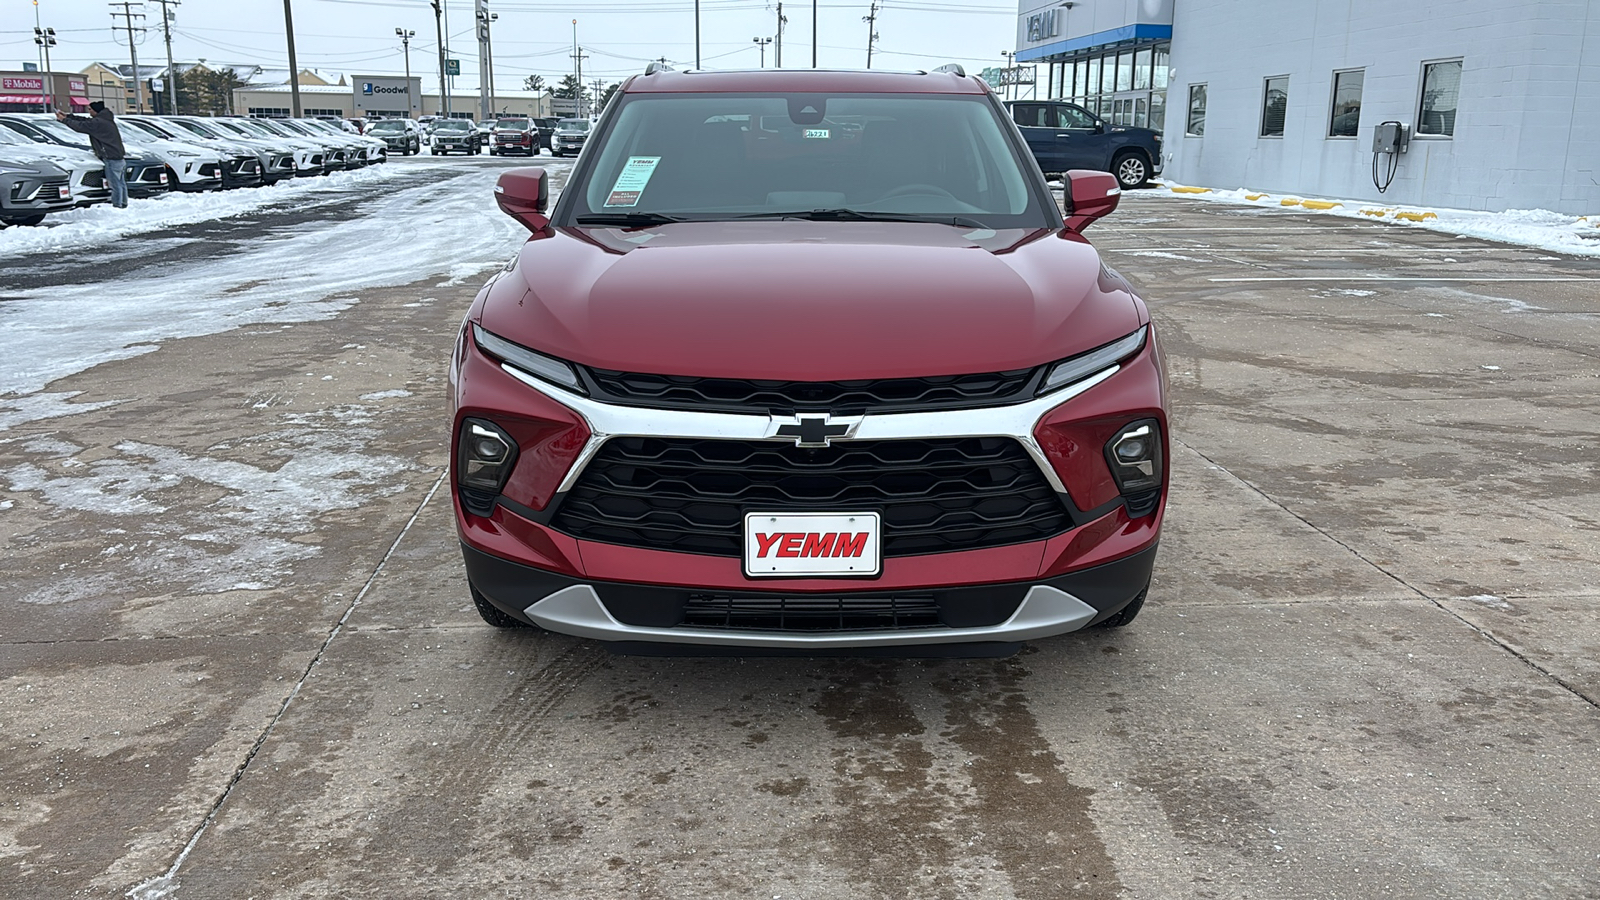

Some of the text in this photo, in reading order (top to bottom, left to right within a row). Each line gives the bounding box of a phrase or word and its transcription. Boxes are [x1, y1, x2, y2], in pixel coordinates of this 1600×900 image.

[1026, 9, 1060, 42] YEMM
[373, 85, 409, 94] Goodwil
[755, 532, 870, 558] YEMM
